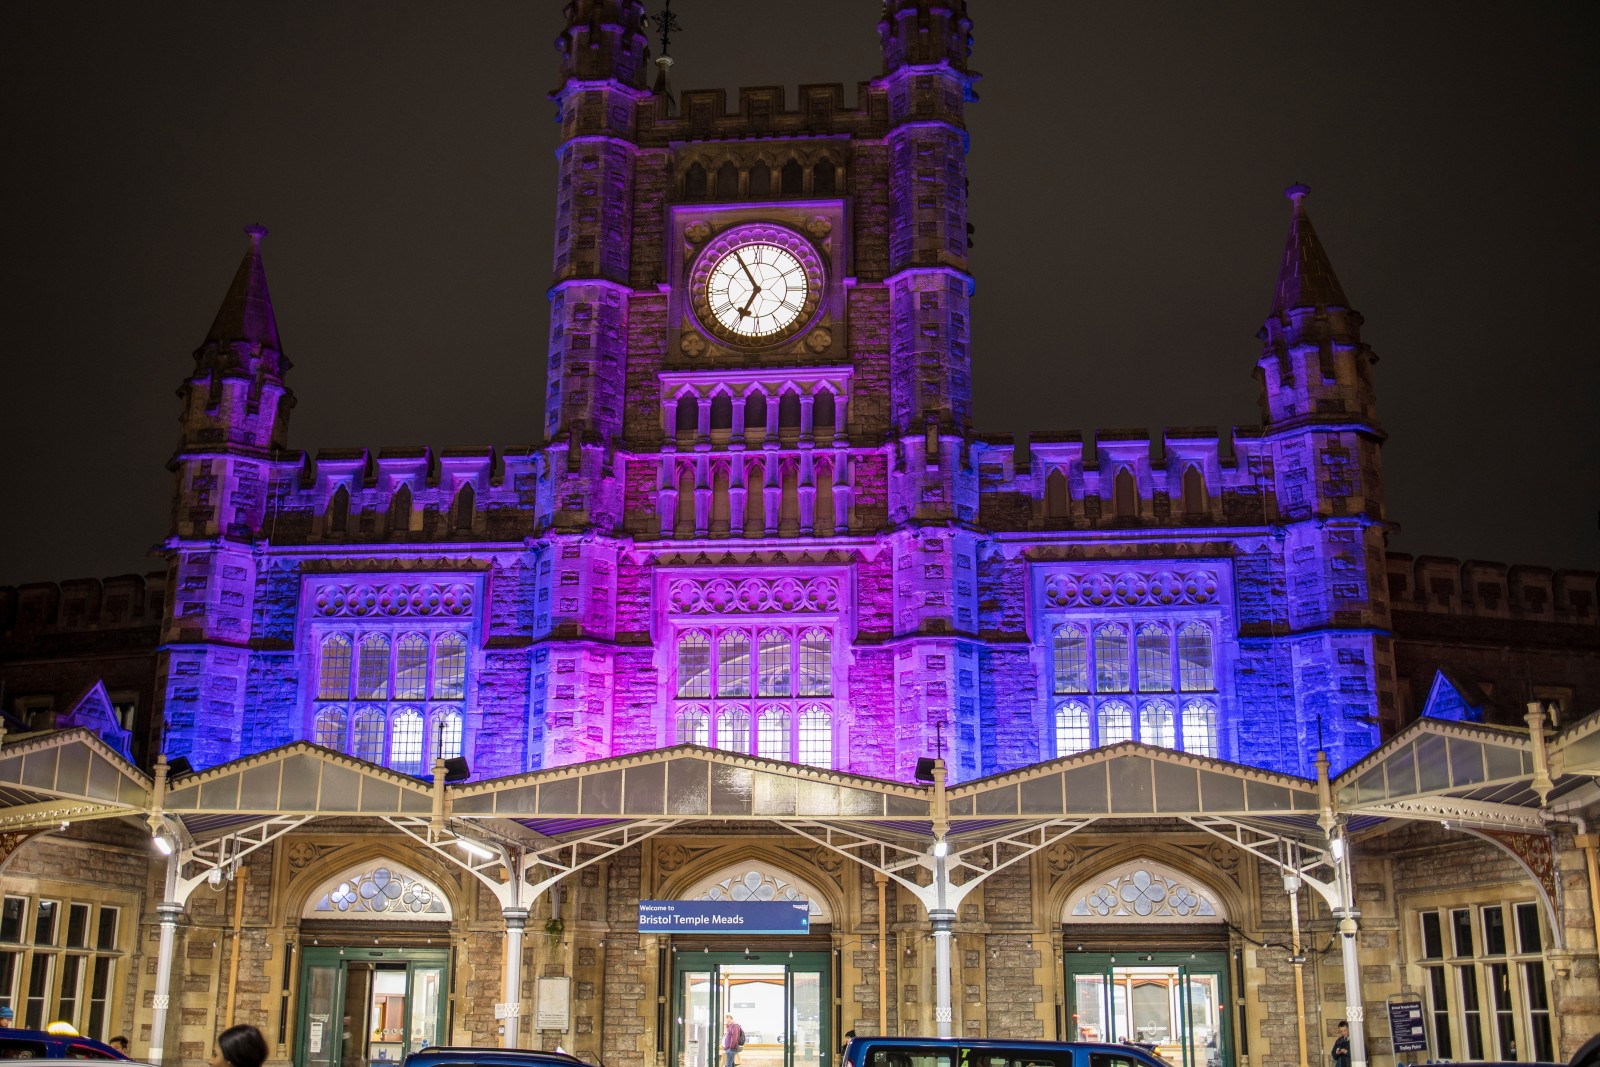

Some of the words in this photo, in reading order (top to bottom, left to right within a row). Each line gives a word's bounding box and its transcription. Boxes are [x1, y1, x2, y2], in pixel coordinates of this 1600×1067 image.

[640, 904, 667, 912] Welcome
[640, 914, 671, 925] Bristol
[673, 914, 709, 926] Temple
[712, 914, 744, 924] Meads
